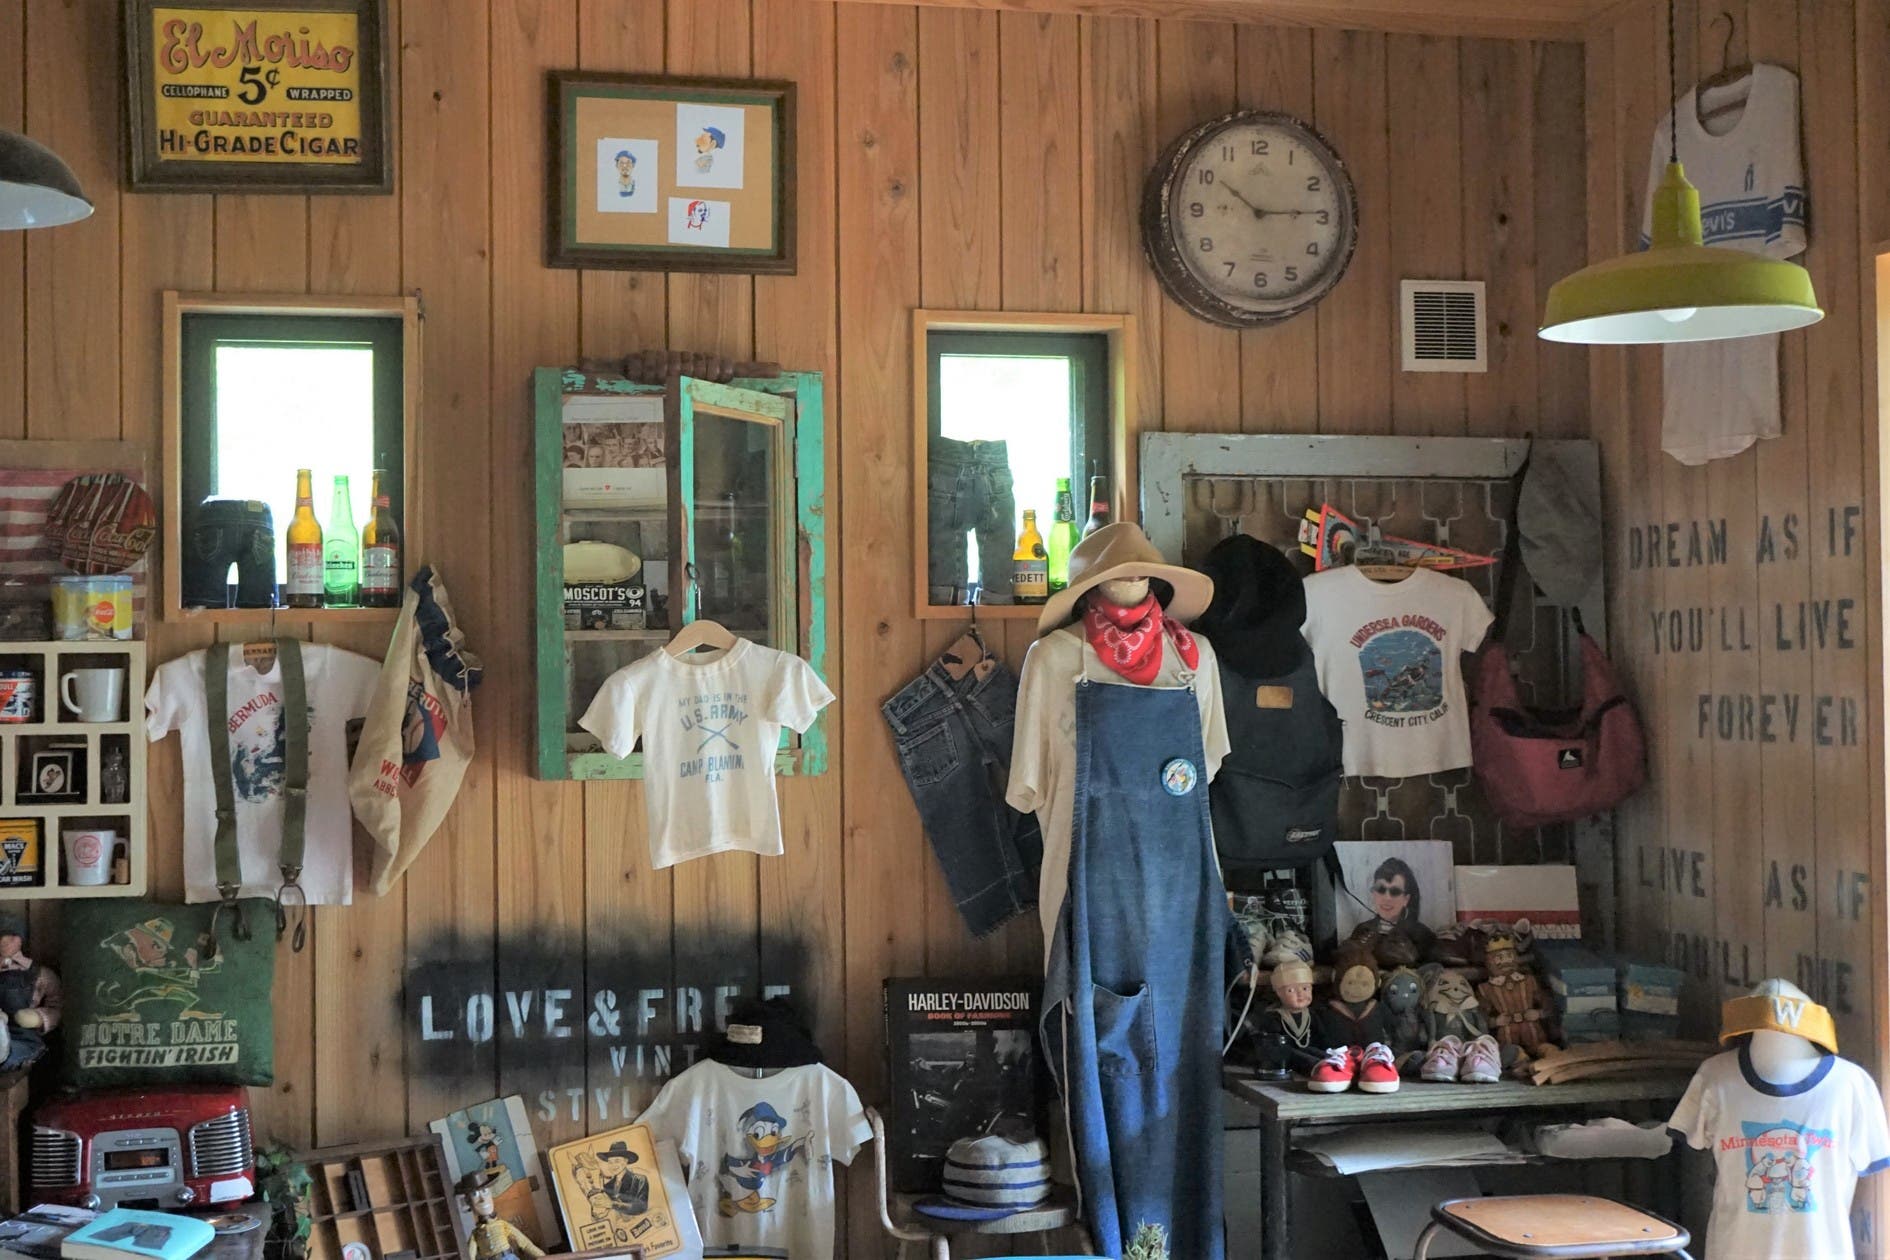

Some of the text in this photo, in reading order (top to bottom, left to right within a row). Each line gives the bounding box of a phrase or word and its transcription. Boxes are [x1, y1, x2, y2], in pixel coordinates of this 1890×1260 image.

[161, 19, 211, 74] El
[163, 85, 351, 100] CELLOPHANE WRAPPED
[188, 110, 333, 128] GUARANTEED
[280, 130, 359, 156] CIGAR
[1250, 140, 1269, 155] 12
[1222, 146, 1234, 162] 11
[1199, 169, 1215, 185] 10
[1306, 176, 1321, 192] 2
[1190, 202, 1204, 217] 9
[1315, 209, 1329, 226] 3
[1200, 237, 1213, 252] 8
[1305, 241, 1319, 257] 4
[1222, 262, 1236, 277] 7
[1284, 266, 1298, 282] 5
[1253, 272, 1268, 288] 6
[1629, 506, 1860, 570] DREAM AS IF
[564, 587, 626, 600] MOSCOT'S
[629, 599, 641, 607] 94
[1349, 614, 1447, 648] UNDERSEA GARDENS
[1651, 599, 1855, 654] YOU'LL LIVE
[679, 697, 690, 706] MY
[694, 696, 709, 704] DAD
[713, 694, 721, 702] IS
[735, 693, 748, 703] THE
[228, 691, 278, 734] BERMUDA
[710, 704, 748, 725] ARMY
[1364, 709, 1405, 727] CRESCENT
[1698, 694, 1858, 746] FOREVER
[680, 758, 703, 777] CAMP
[1638, 845, 1869, 921] LIVE AS IF
[908, 992, 1030, 1011] HARLEY-DAVIDSON
[421, 985, 791, 1042] LOVE & FRE
[1775, 996, 1804, 1028] W
[80, 1019, 237, 1046] NOTRE DAME
[84, 1046, 233, 1066] FIGHTIN' IRISH
[610, 1044, 700, 1077] VINT
[538, 1087, 636, 1122] STYL
[1720, 1133, 1798, 1152] Minnesota
